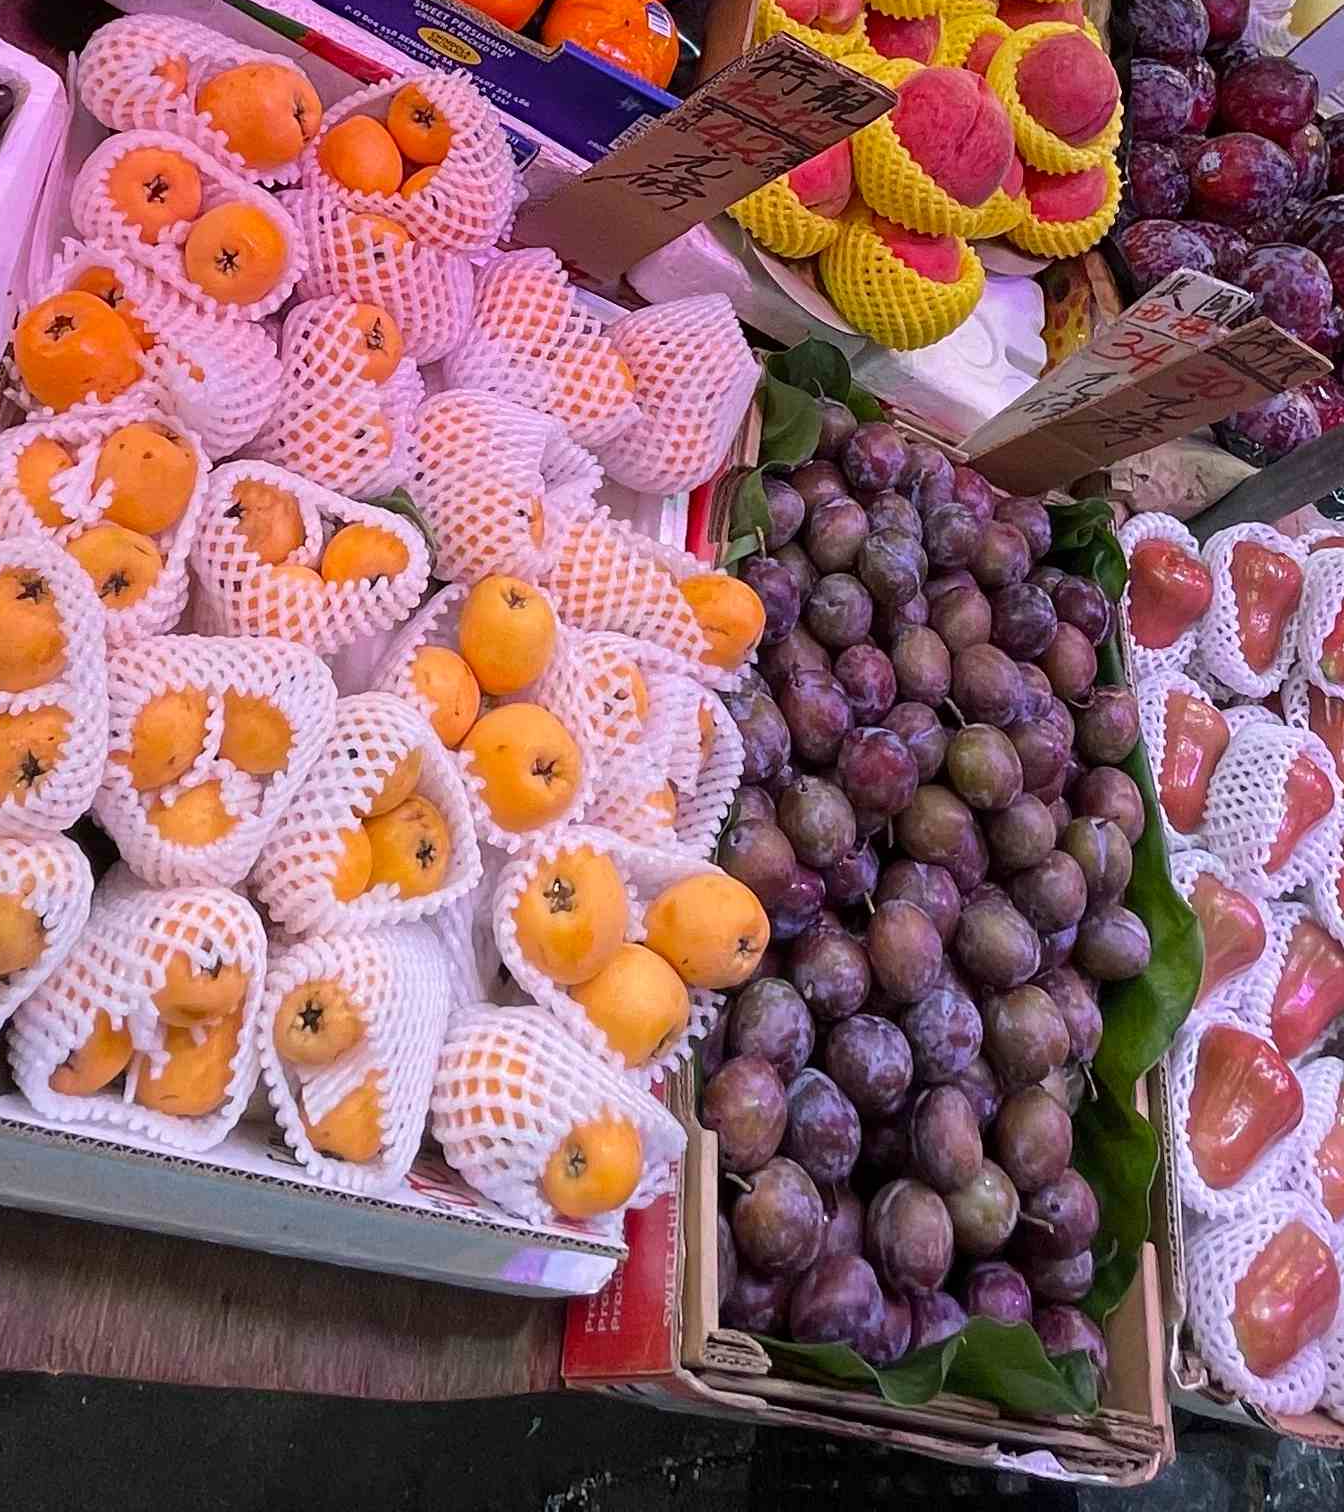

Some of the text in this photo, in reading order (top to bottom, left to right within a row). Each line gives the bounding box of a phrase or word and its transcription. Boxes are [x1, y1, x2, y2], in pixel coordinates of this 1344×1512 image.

[413, 0, 517, 58] SWEET PERSIMMON
[415, 10, 449, 32] GROWN
[457, 30, 492, 55] PACKED
[491, 48, 505, 61] BY
[582, 163, 709, 212] 磅
[675, 151, 735, 186] 元
[1093, 331, 1169, 376] 34
[1067, 371, 1120, 405] 元
[663, 1250, 678, 1328] SWEET
